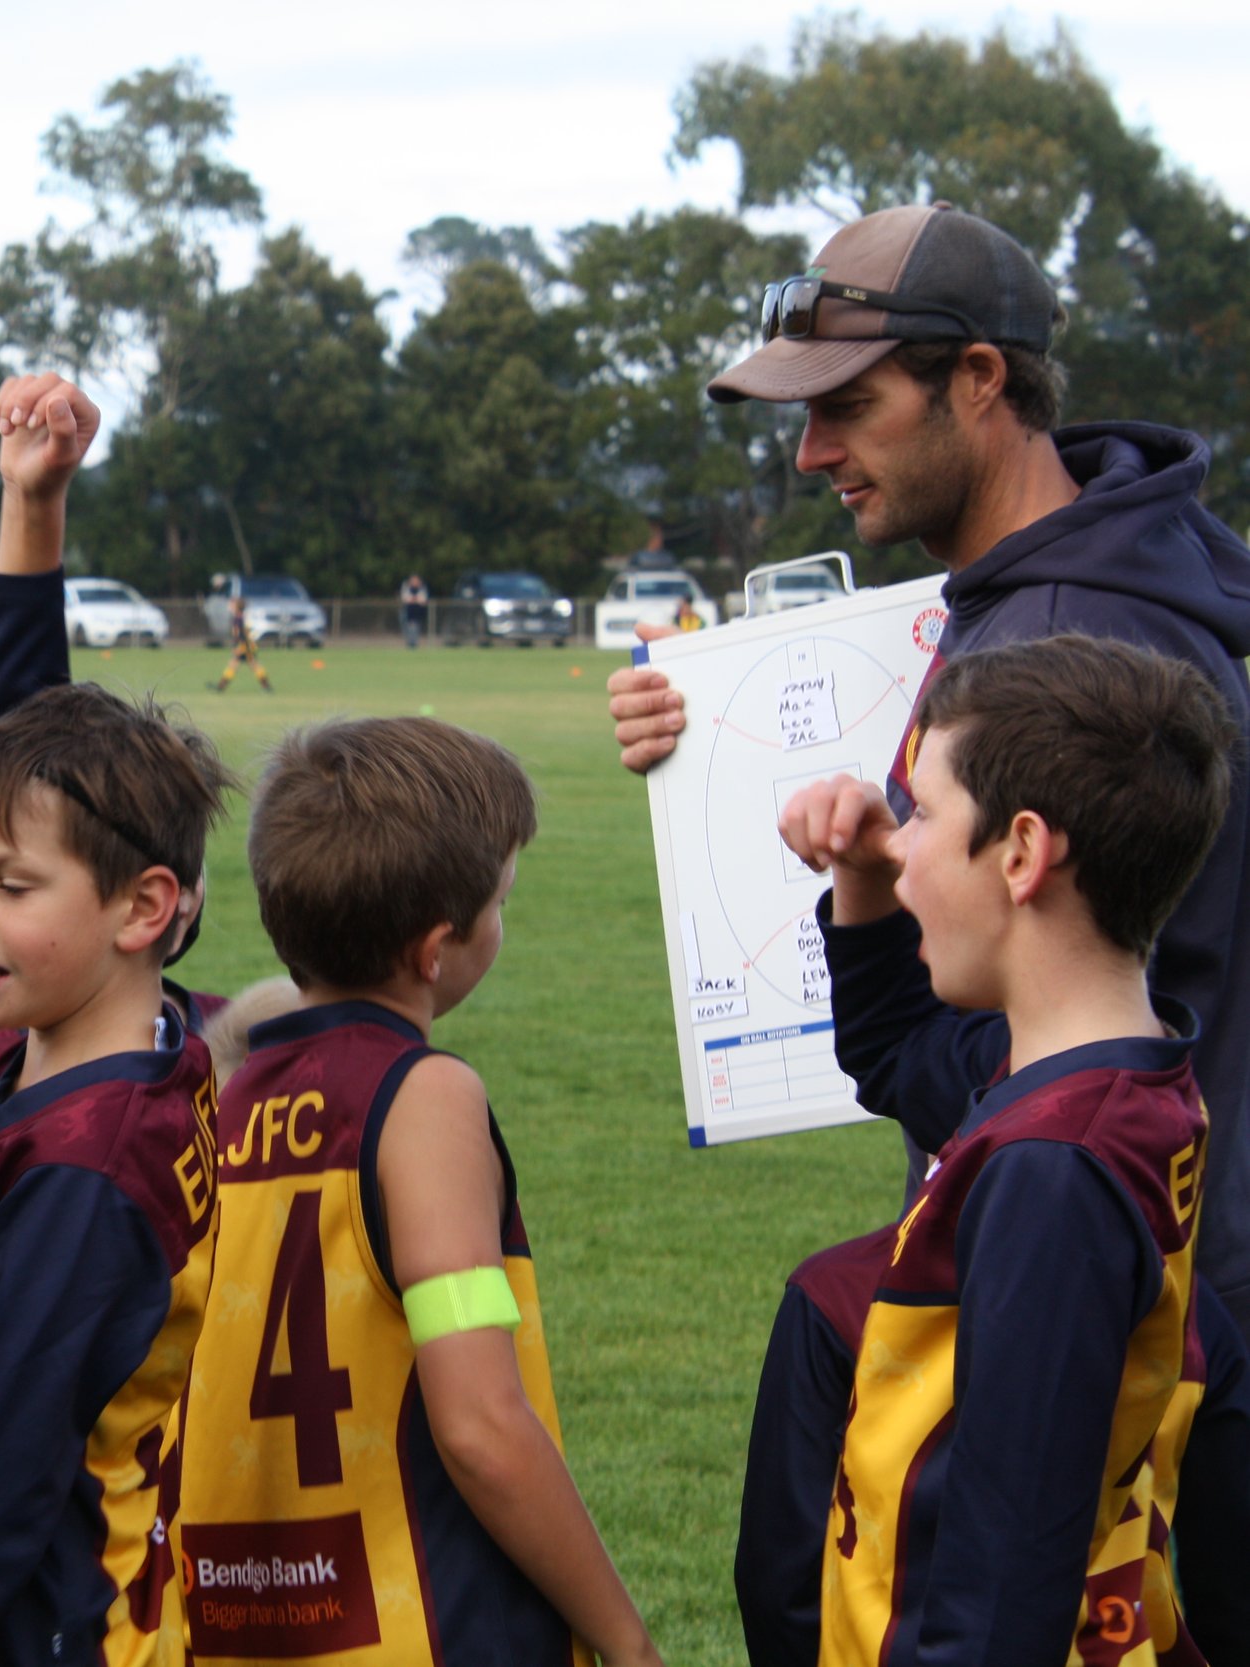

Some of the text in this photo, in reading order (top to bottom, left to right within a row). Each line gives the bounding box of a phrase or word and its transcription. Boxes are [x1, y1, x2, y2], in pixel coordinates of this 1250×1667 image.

[695, 977, 737, 993] JACK
[217, 1090, 325, 1168] JFC
[249, 1188, 353, 1488] 4
[197, 1553, 338, 1593] Bendigo Bank
[202, 1601, 249, 1630] Bigger
[288, 1596, 344, 1625] bank
